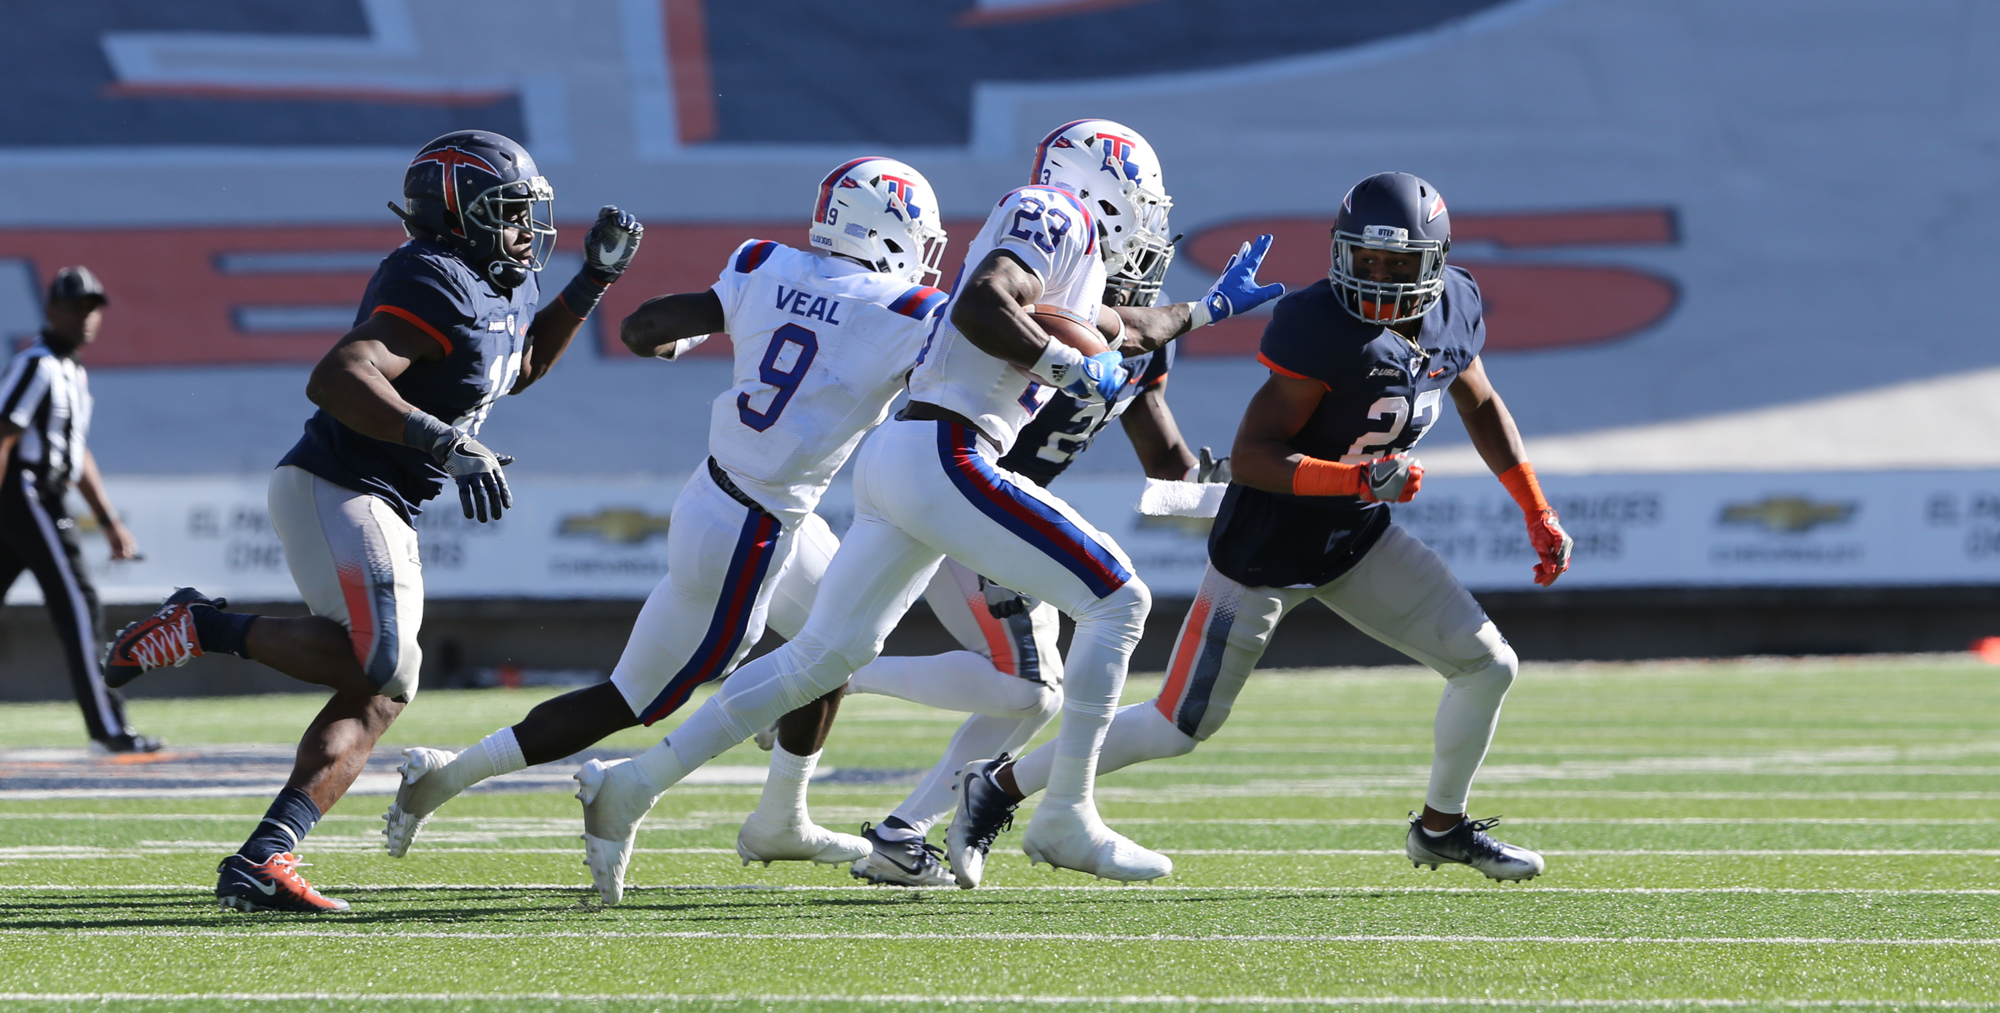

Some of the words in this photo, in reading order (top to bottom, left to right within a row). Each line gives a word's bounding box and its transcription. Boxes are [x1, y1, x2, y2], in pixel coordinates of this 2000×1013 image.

[828, 207, 839, 226] 9
[1009, 196, 1072, 254] 23
[1378, 228, 1395, 237] UTEP
[776, 285, 840, 325] VEAL
[737, 322, 819, 433] 9
